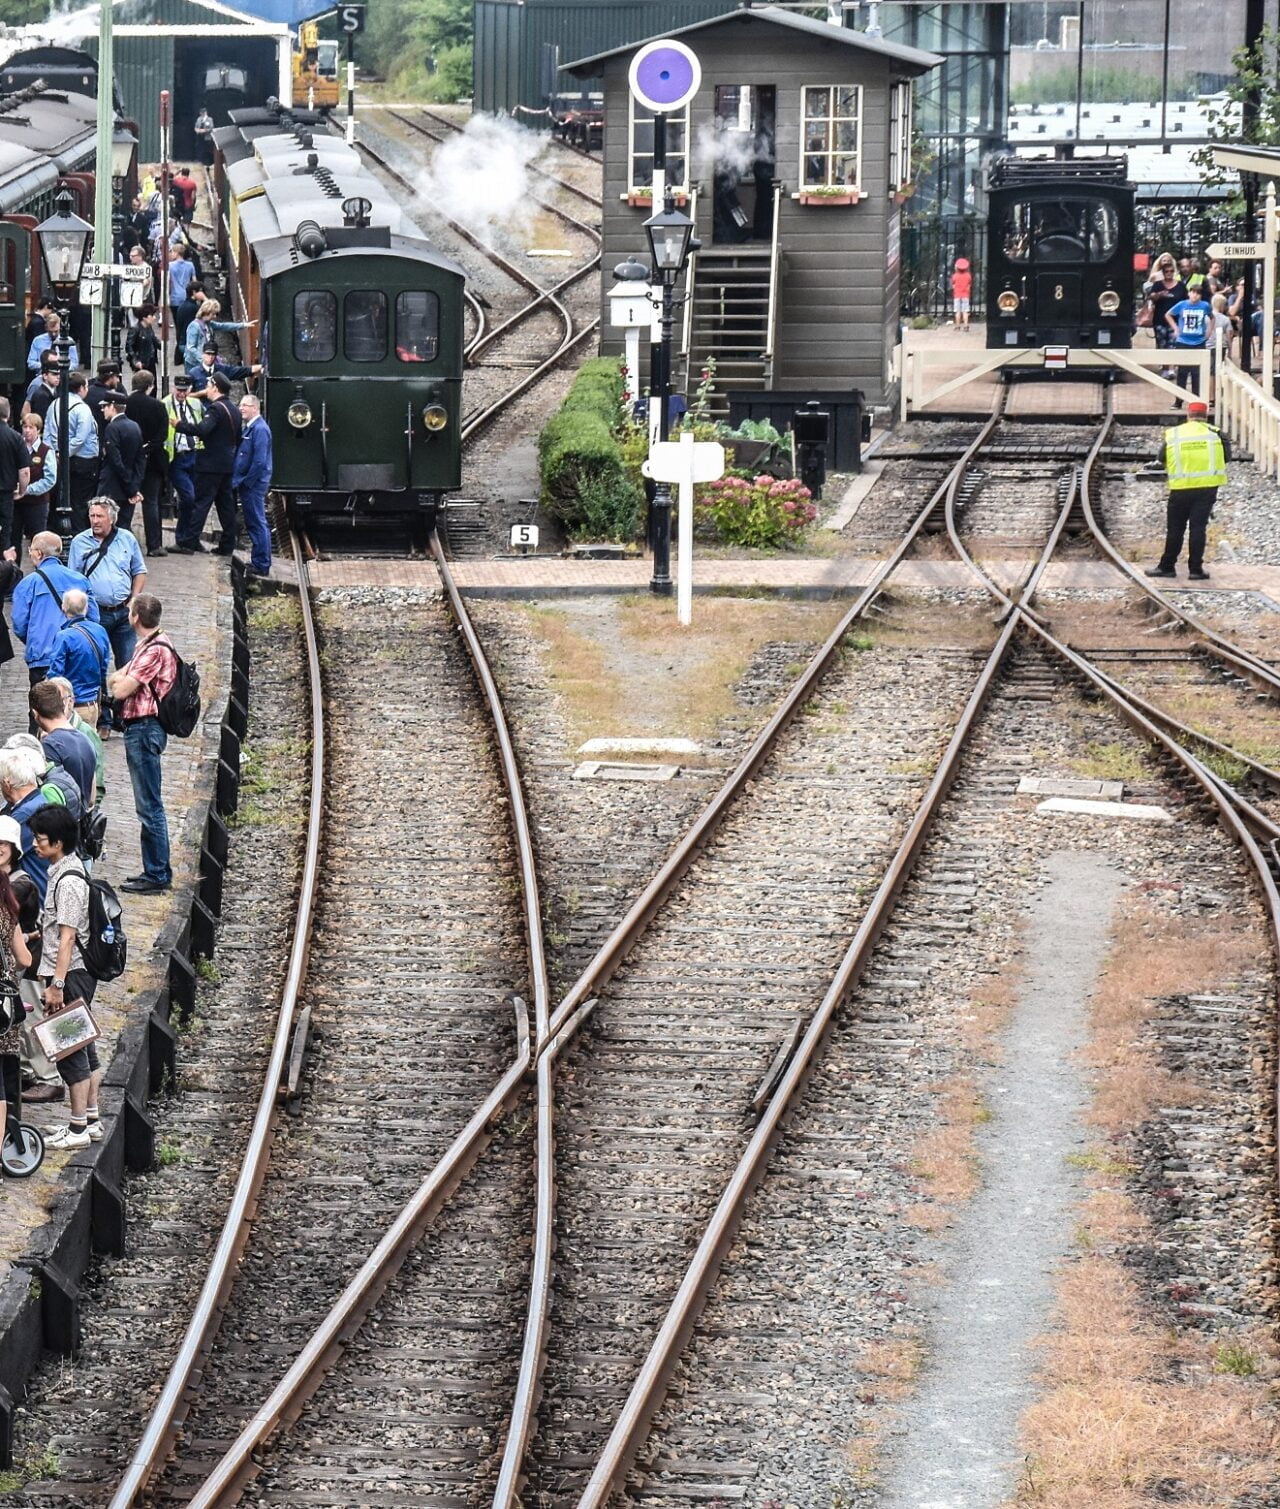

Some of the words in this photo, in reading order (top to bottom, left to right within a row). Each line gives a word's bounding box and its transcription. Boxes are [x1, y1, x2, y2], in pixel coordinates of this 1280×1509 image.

[342, 7, 359, 31] S
[1223, 246, 1256, 256] SEINHUIS
[94, 264, 100, 277] 8
[125, 266, 145, 277] SPOOR
[145, 266, 151, 279] 9
[1055, 284, 1063, 300] 8
[520, 526, 530, 542] 5
